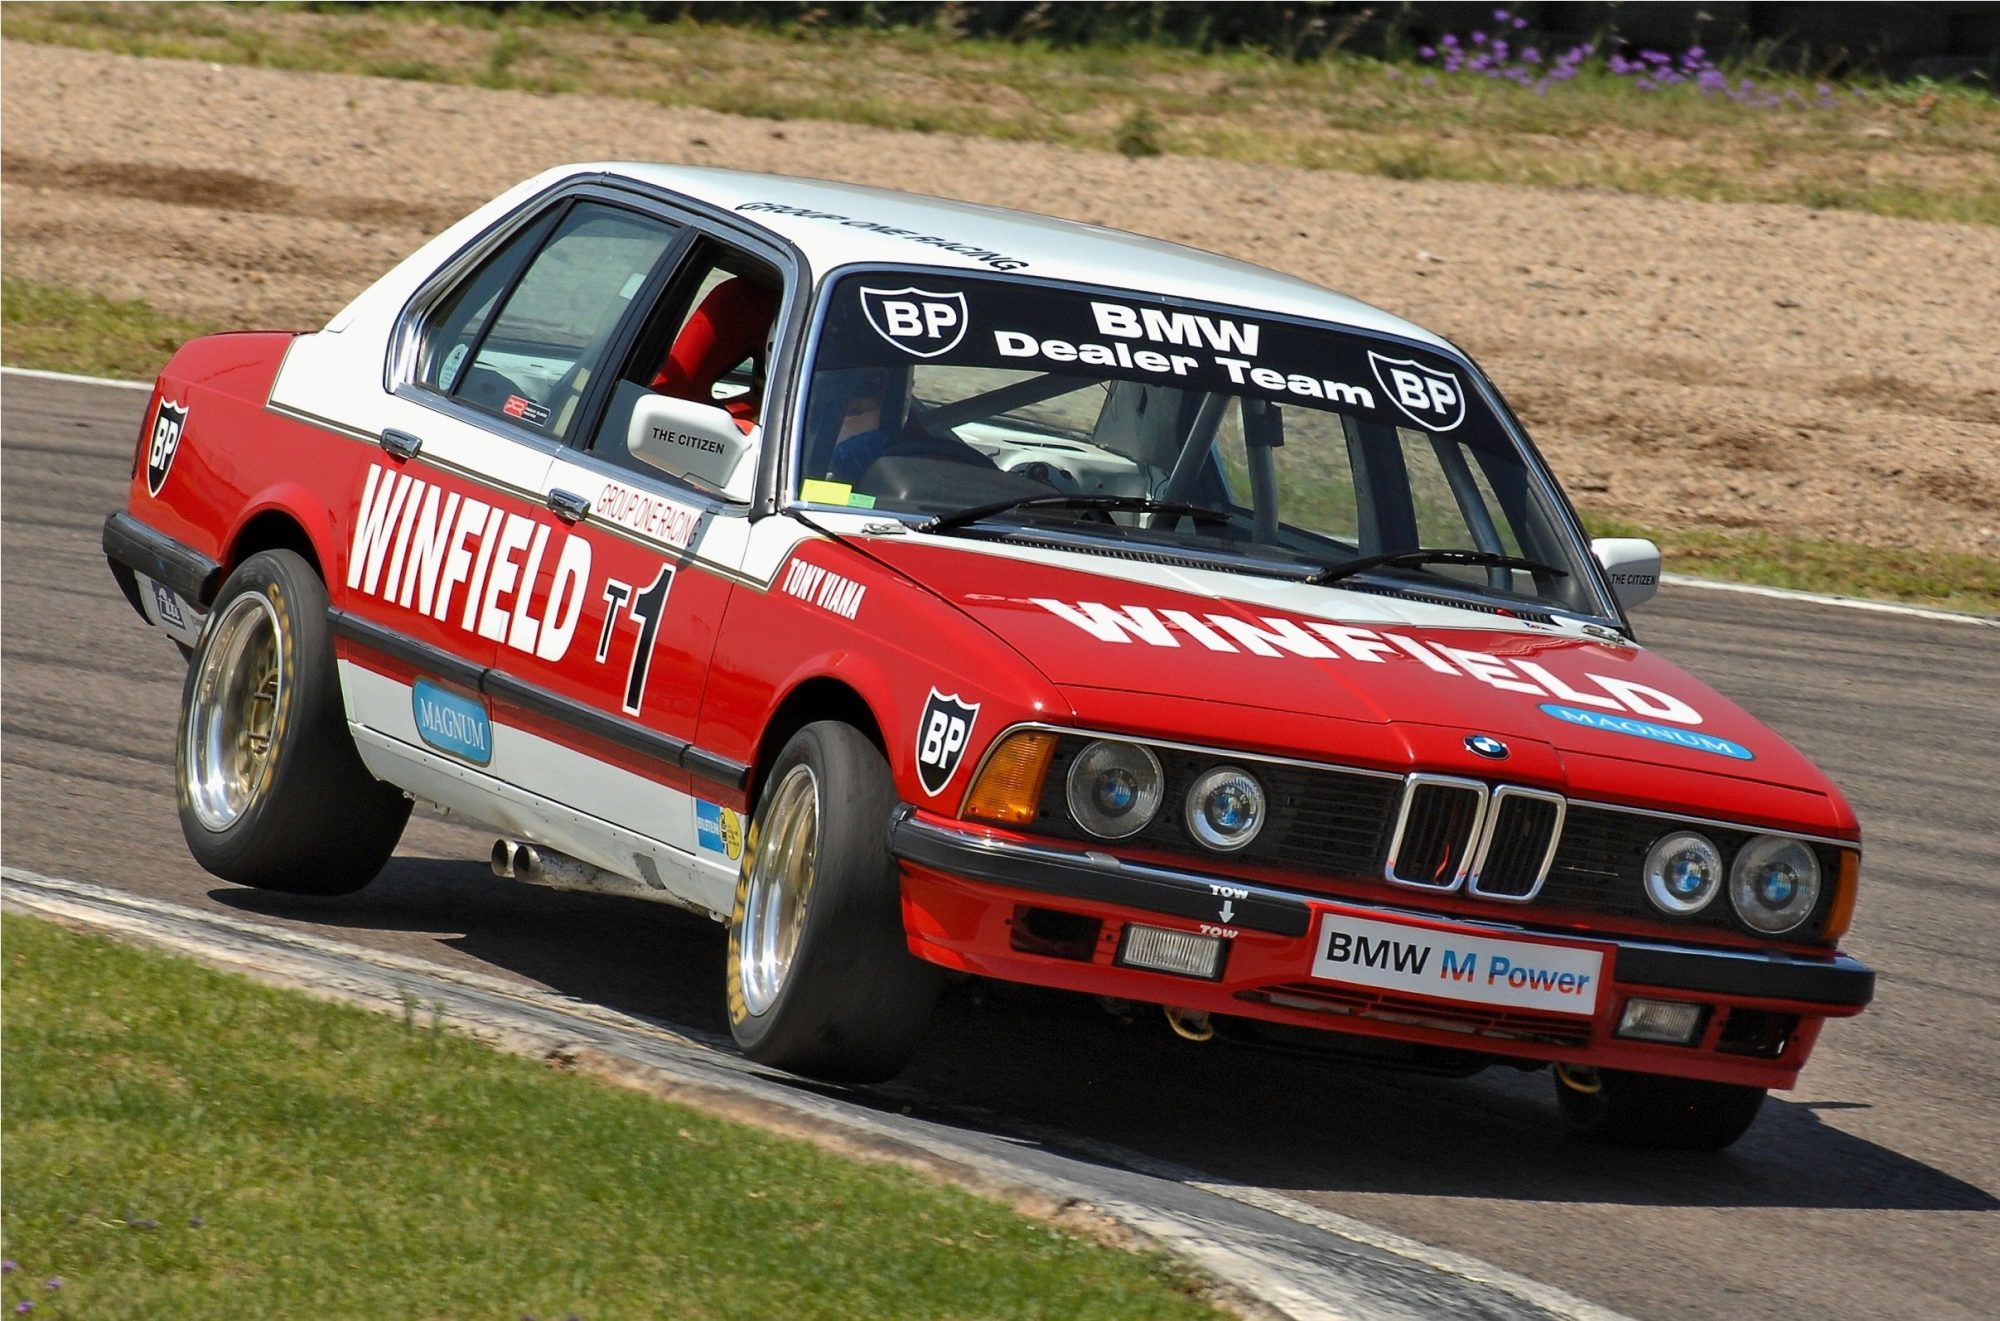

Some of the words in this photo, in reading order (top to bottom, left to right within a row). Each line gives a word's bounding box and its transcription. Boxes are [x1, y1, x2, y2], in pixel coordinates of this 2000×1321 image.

[734, 202, 850, 220] GROUP
[840, 221, 919, 235] ONE
[903, 236, 1029, 271] RACING
[882, 301, 957, 340] BP
[1090, 302, 1261, 357] BMW
[994, 330, 1200, 377] Dealer
[1214, 356, 1377, 410] Team
[1391, 367, 1458, 415] BP
[151, 417, 178, 471] BP
[652, 427, 676, 443] THE
[678, 433, 725, 455] CITIZEN
[597, 484, 639, 522] GROUP
[634, 497, 663, 532] ONE
[656, 506, 702, 547] RACING
[346, 462, 592, 663] WINFIELD
[782, 557, 827, 602] TONY
[816, 570, 867, 620] VIANA
[1611, 573, 1625, 585] THE
[1627, 574, 1657, 586] CITIZEN
[1029, 598, 1704, 725] WINFIELD
[420, 697, 486, 751] MAGNUM
[920, 709, 966, 769] BP
[1558, 708, 1737, 755] MAGNUM
[1209, 884, 1249, 900] TOW
[1200, 924, 1239, 939] TOW
[1325, 931, 1431, 975] BMW
[1440, 949, 1477, 983] M
[1487, 955, 1590, 995] Power
